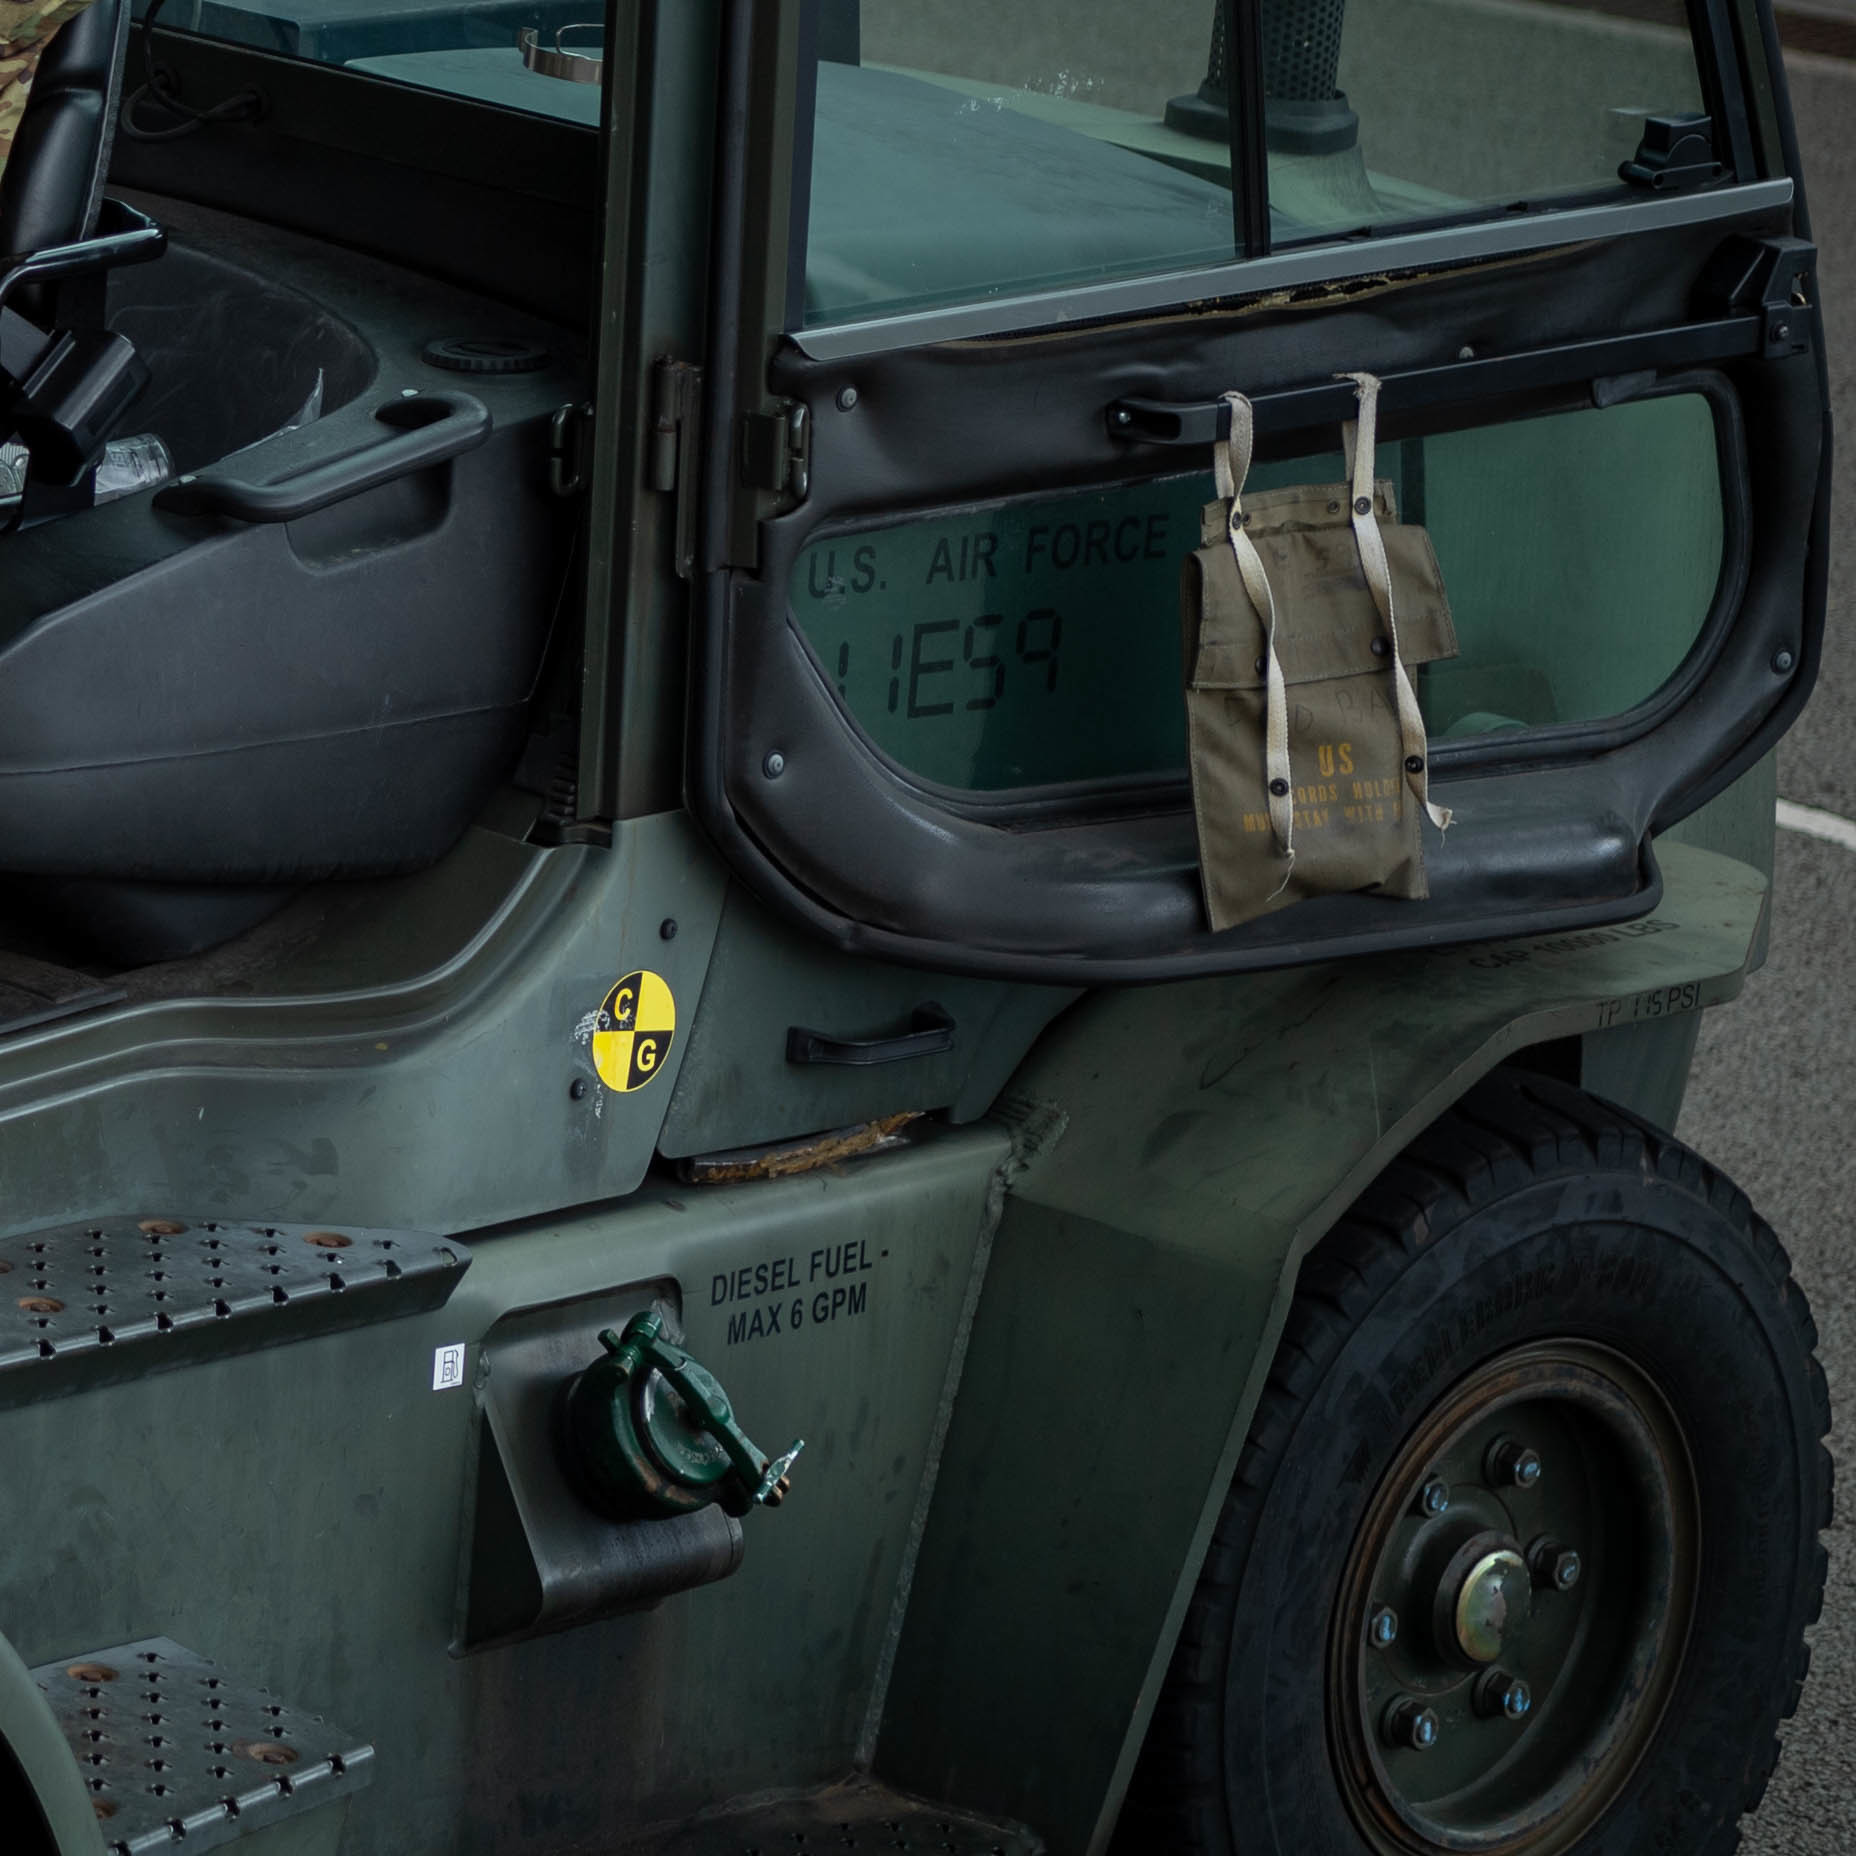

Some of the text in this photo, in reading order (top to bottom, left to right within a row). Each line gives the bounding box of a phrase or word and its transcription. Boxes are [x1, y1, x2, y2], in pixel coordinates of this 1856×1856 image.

[807, 514, 1171, 599] U.S. AIR FORCE
[1317, 743, 1355, 778] US
[1293, 782, 1338, 805] ORDS
[1344, 801, 1385, 825] WITH
[1610, 919, 1681, 939] LBS
[614, 987, 634, 1022] C
[1595, 999, 1622, 1026] TP
[1667, 982, 1701, 1012] PSI
[636, 1037, 657, 1072] G
[710, 1257, 801, 1306] DIESEL
[809, 1239, 873, 1283] FUEL
[726, 1281, 867, 1346] MAX 6 GPM
